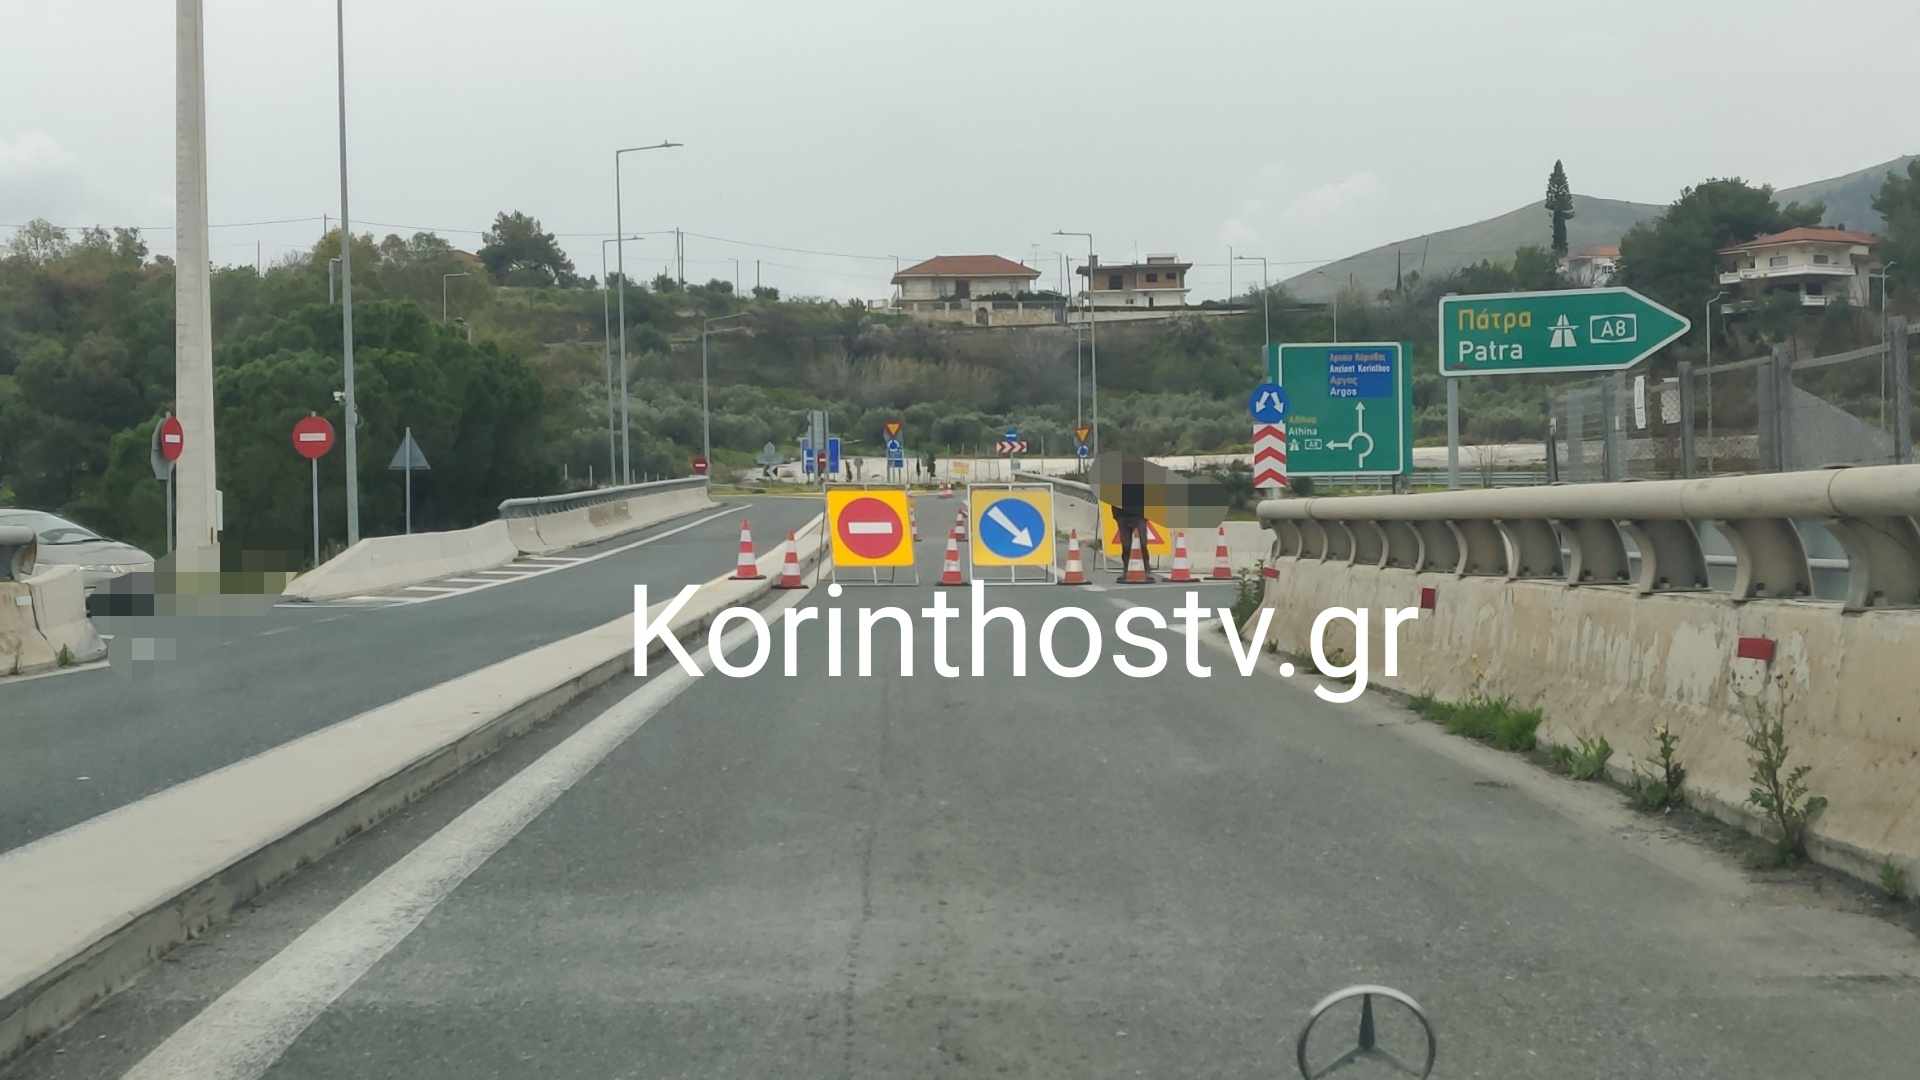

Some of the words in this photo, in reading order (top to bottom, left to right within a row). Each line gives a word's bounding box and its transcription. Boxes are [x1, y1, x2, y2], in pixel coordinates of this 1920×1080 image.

[1458, 308, 1532, 334] Πάτρα
[1600, 320, 1627, 338] A8
[1458, 340, 1524, 362] Patra
[1329, 387, 1357, 397] Argos
